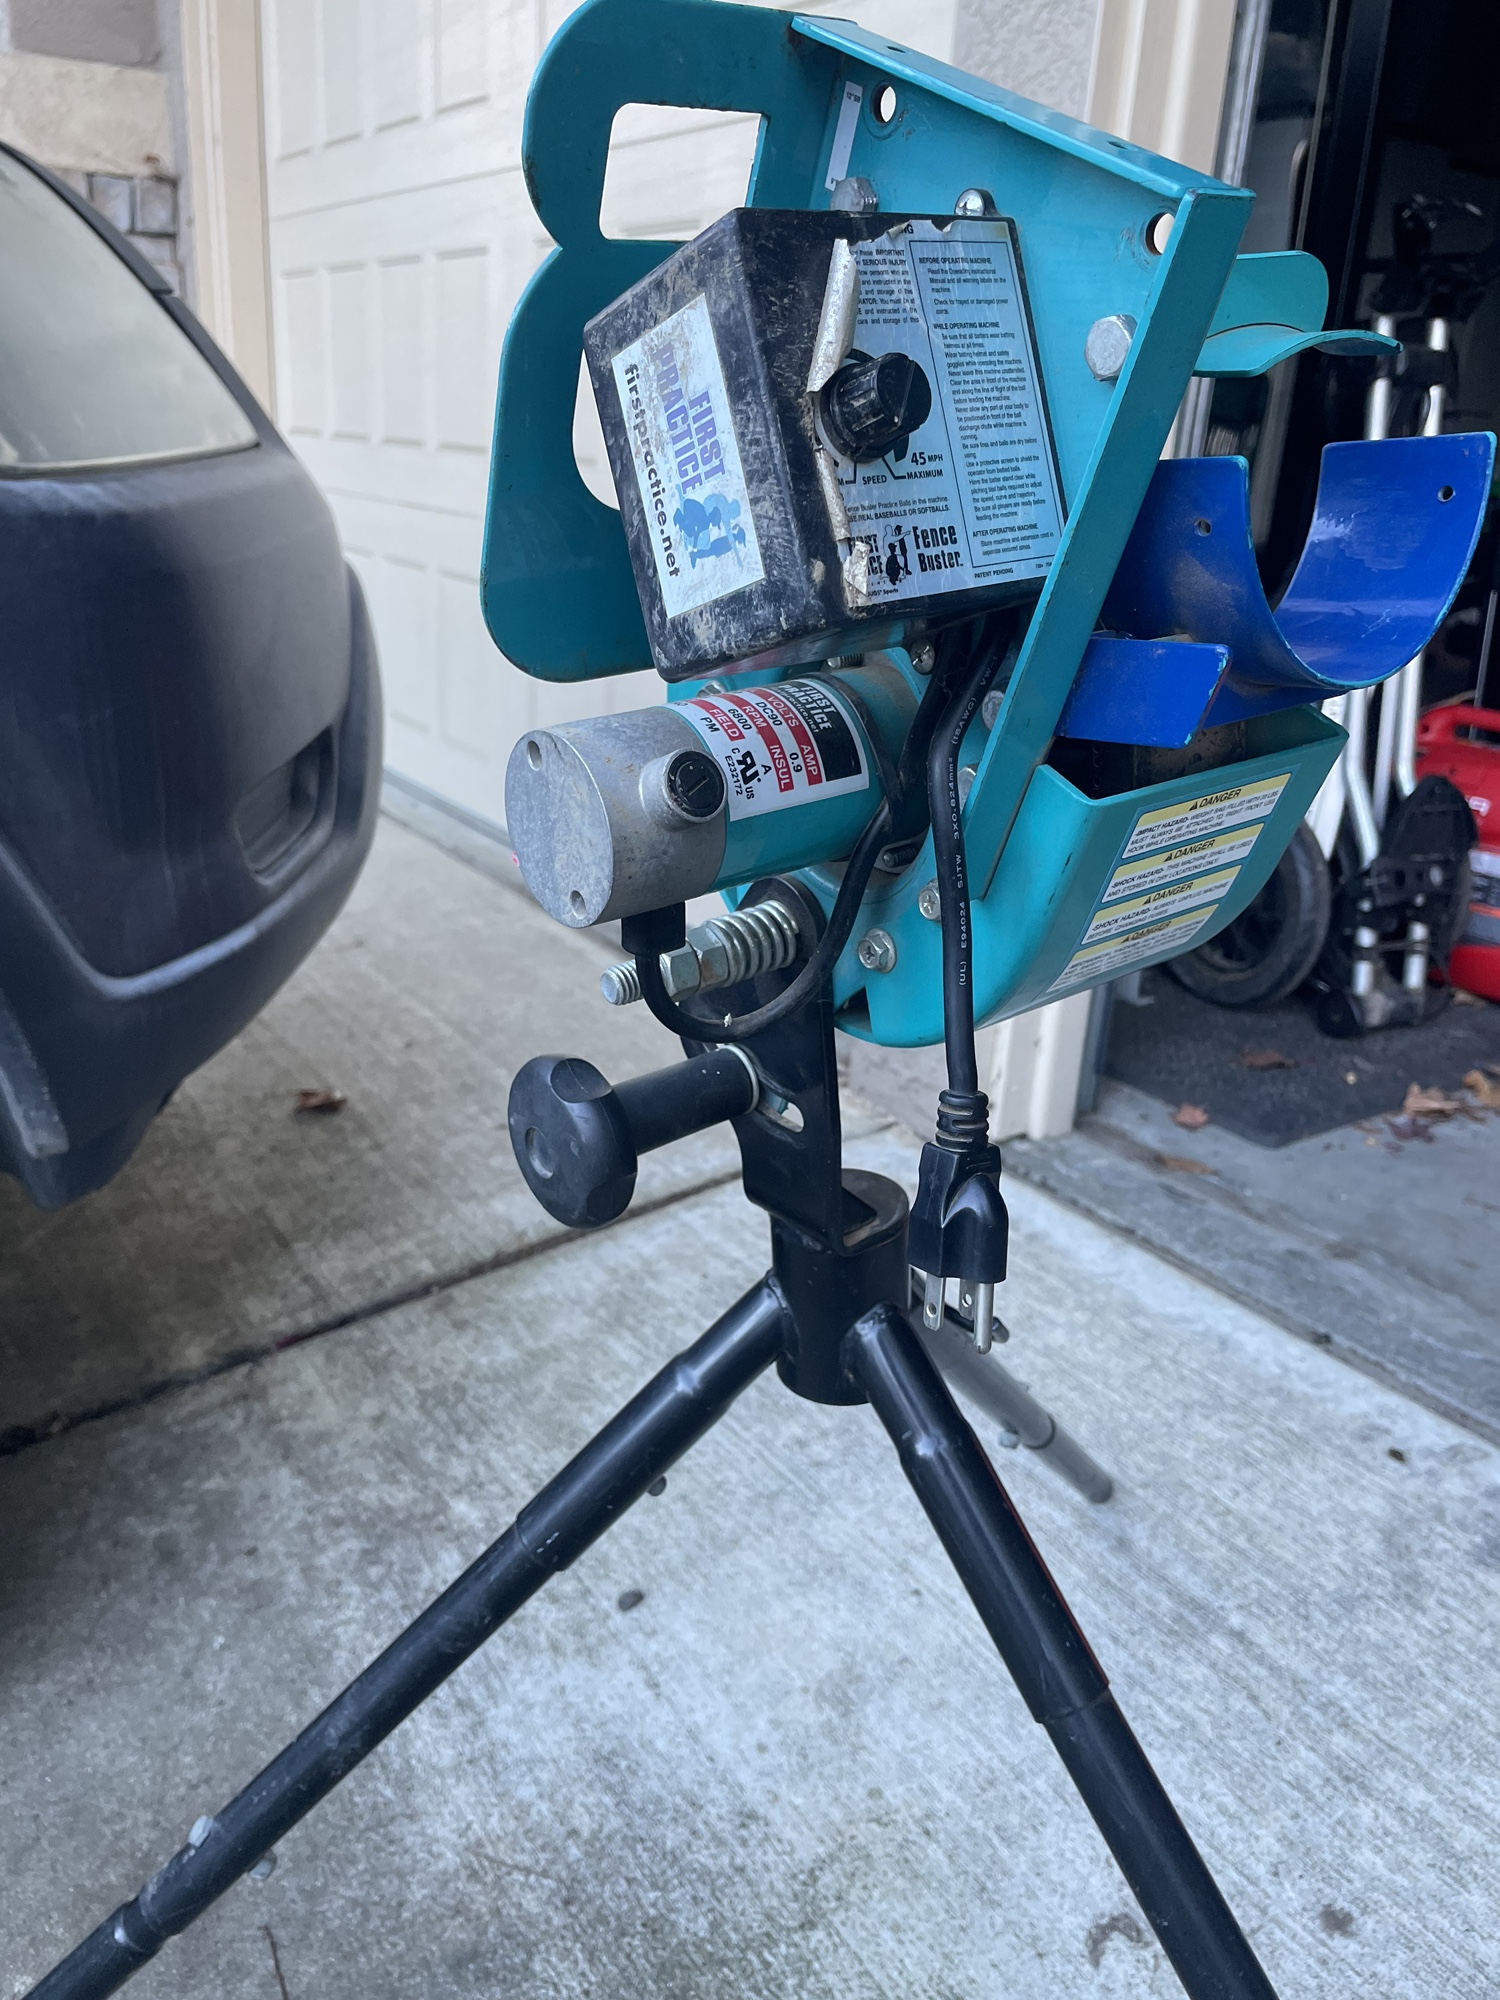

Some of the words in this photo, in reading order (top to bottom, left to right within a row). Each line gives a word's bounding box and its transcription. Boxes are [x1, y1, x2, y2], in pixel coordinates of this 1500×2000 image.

[651, 341, 704, 495] PRACTICE
[688, 390, 726, 480] FIRST
[624, 362, 681, 578] firstpractice.net
[911, 452, 927, 466] 45
[928, 454, 943, 462] MPH
[862, 475, 887, 485] SPEED
[907, 469, 943, 480] MAXIMUM
[861, 503, 876, 511] Buster
[875, 509, 907, 519] BASEBALLS
[918, 505, 950, 514] SOFTBALLS.
[912, 525, 958, 550] Fence
[973, 529, 988, 537] AFTER
[990, 526, 1016, 535] OPERATING
[1017, 523, 1038, 531] MACHINE
[993, 568, 1013, 576] PENDING
[778, 685, 832, 730] PRACTICE
[800, 687, 836, 713] FIRST
[700, 717, 720, 732] PM
[710, 709, 739, 737] FIELD
[728, 709, 752, 730] 6800
[761, 764, 772, 775] A
[756, 702, 782, 726] DC90
[789, 752, 803, 773] 0.9
[768, 696, 799, 727] VOLTS
[800, 744, 818, 776] AMP
[742, 706, 767, 728] RPM
[769, 745, 791, 789] INSUL
[725, 756, 743, 796] E232172
[745, 786, 754, 799] US
[1199, 789, 1242, 808] DANGER
[1174, 839, 1215, 858] DANGER
[1152, 882, 1193, 901] DANGER
[1130, 921, 1172, 943] DANGER
